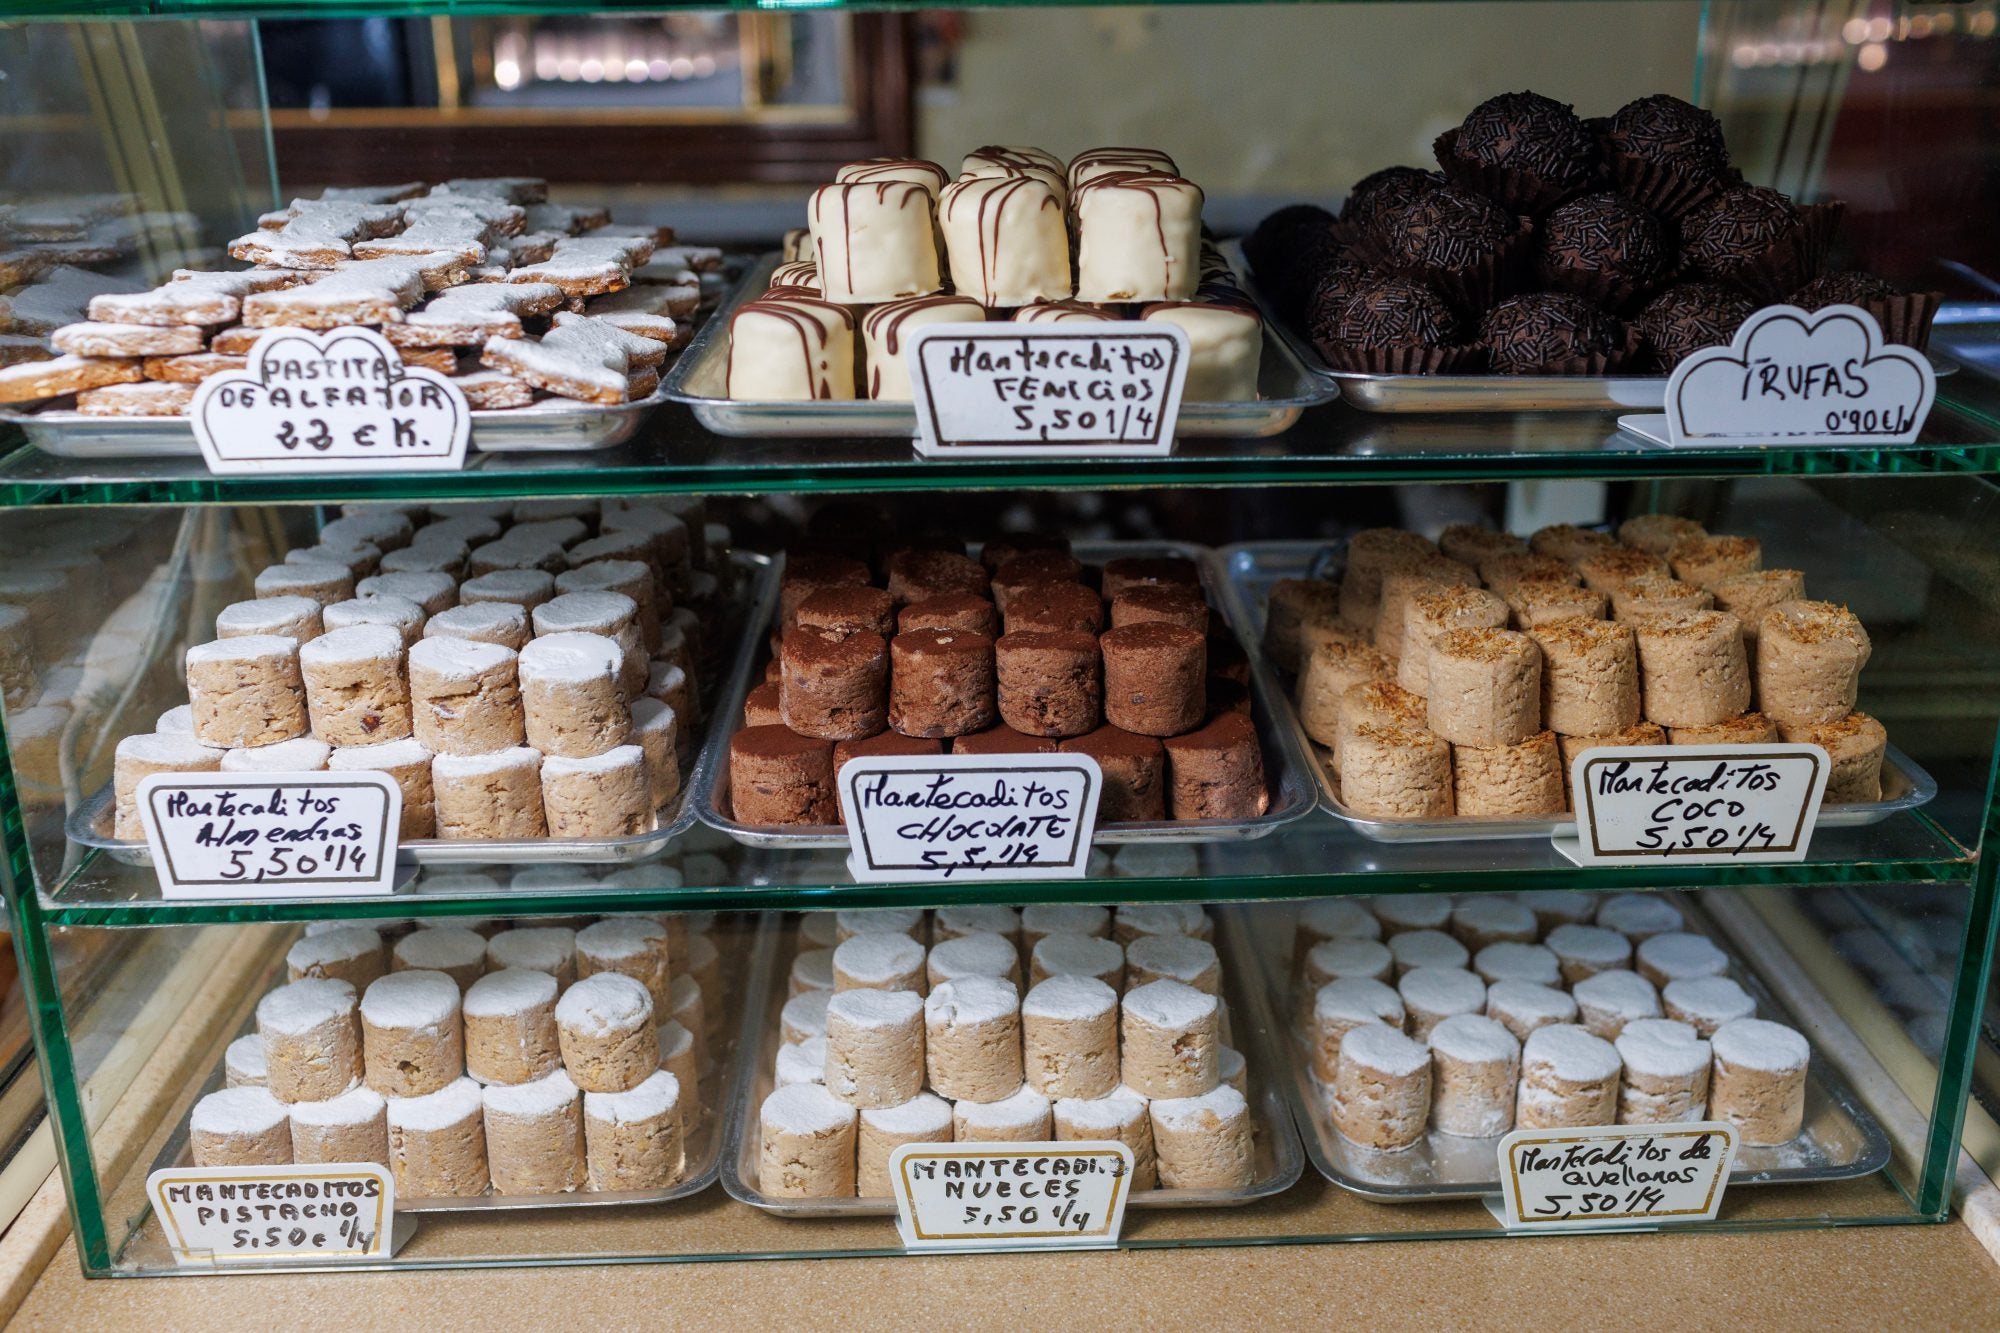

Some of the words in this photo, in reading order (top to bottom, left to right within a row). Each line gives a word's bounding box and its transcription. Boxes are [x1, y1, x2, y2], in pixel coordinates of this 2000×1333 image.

[1742, 356, 1869, 400] TRUFAS
[220, 387, 255, 409] DE
[1651, 799, 1745, 823] COCO
[1678, 1133, 1712, 1161] de
[169, 1178, 380, 1204] MANTECADITOS
[945, 1179, 1082, 1199] NUECES
[197, 1201, 358, 1226] PISTACHO
